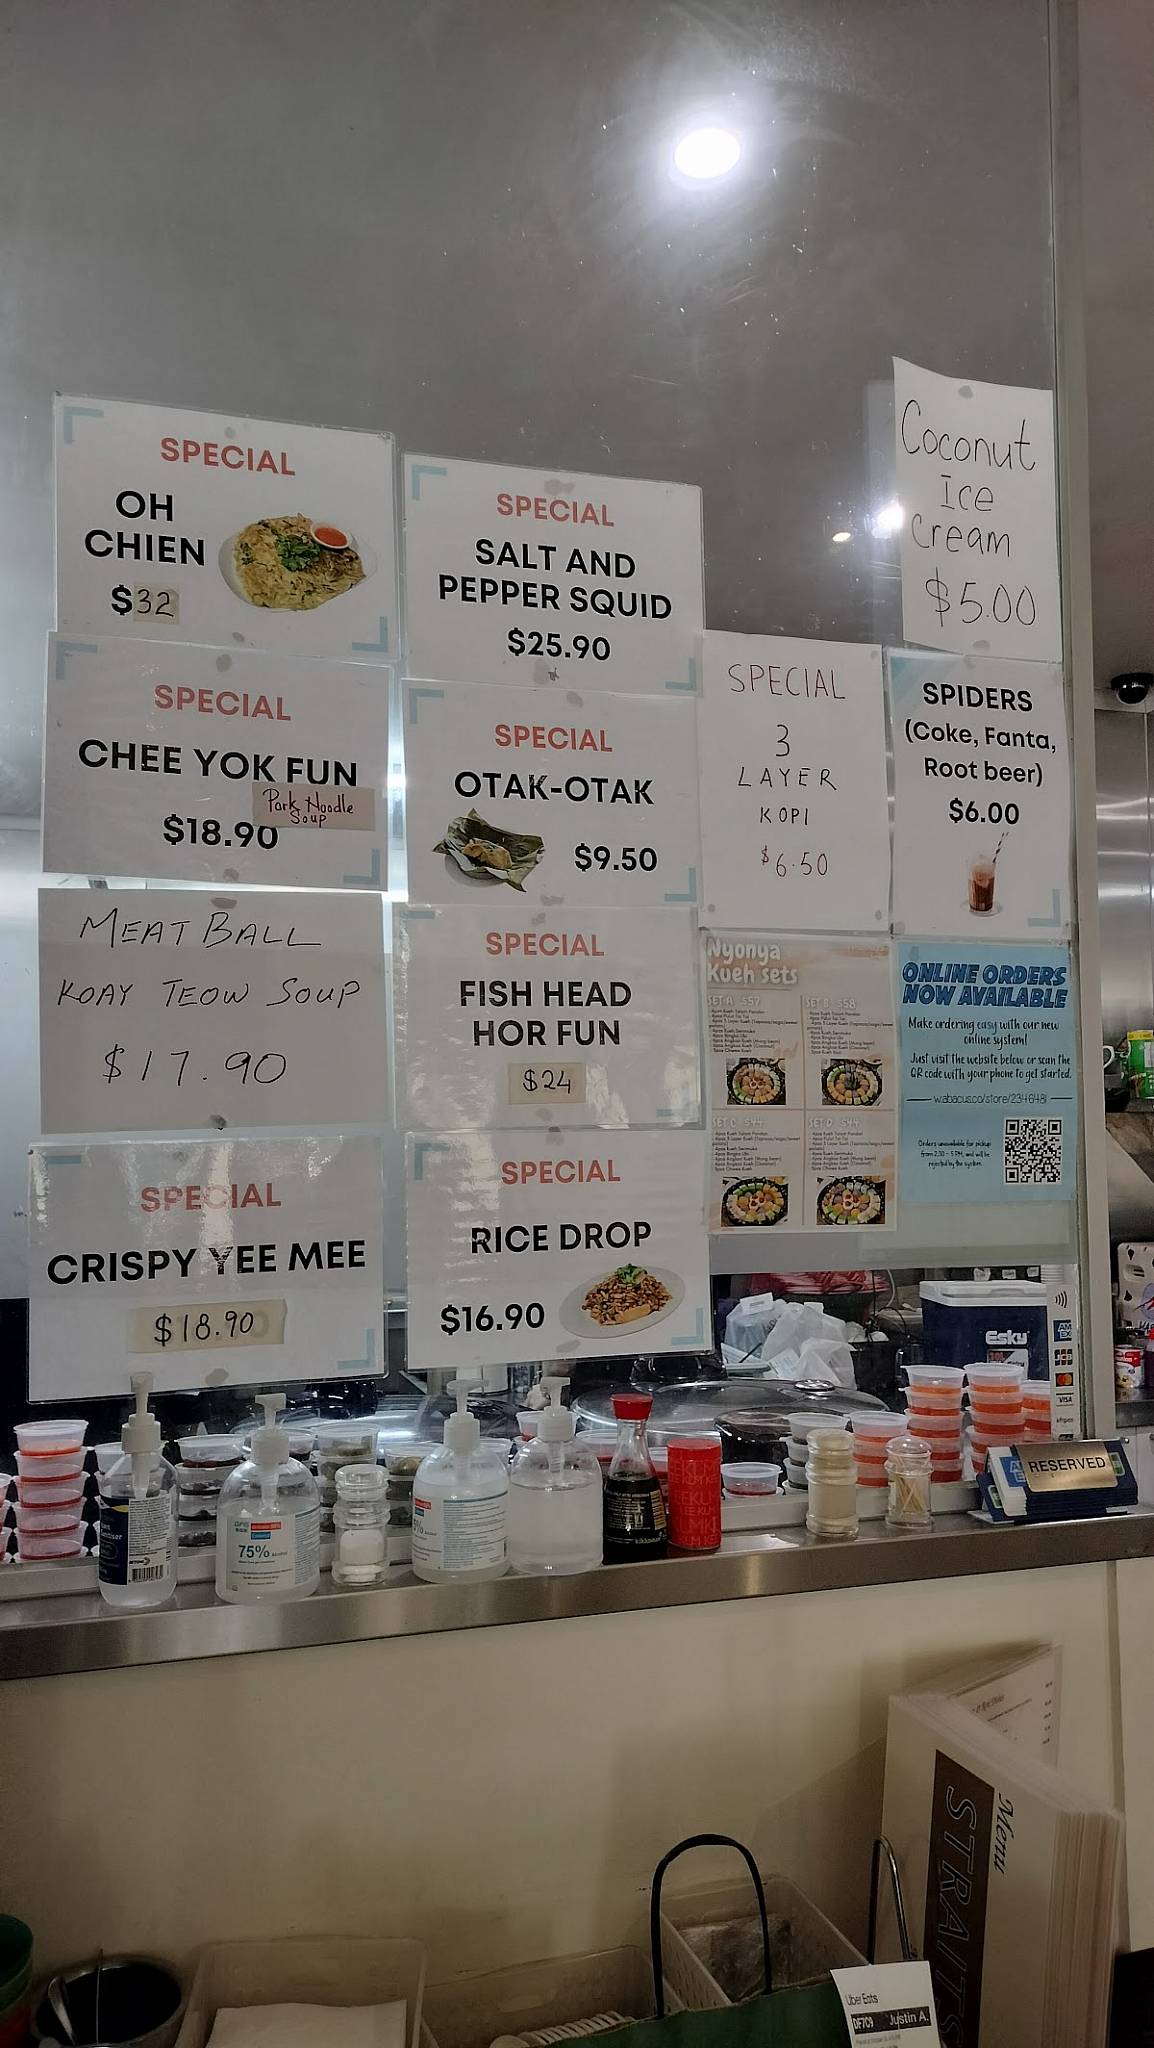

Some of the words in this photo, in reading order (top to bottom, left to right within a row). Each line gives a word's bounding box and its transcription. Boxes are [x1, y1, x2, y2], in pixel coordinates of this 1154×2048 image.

[901, 399, 1036, 472] Coconut
[160, 437, 296, 477] SPECIAL
[115, 490, 174, 523] OH
[941, 475, 994, 512] Ice
[496, 493, 615, 528] SPECIAL
[84, 529, 205, 567] CHIEN
[475, 538, 557, 571] SALT
[566, 549, 636, 579] AND
[111, 584, 175, 616] $32
[439, 574, 561, 611] PEPPER
[570, 587, 672, 620] SQUID
[924, 567, 1037, 628] $5.00
[507, 627, 611, 661] $25.90
[727, 663, 845, 700] SPECIAL
[922, 682, 1033, 712] SPIDERS
[154, 684, 291, 721] SPECIAL
[495, 724, 614, 753] SPECIAL
[776, 724, 791, 757] 3
[905, 718, 979, 748] (Coke,
[985, 726, 1056, 753] Fanta,
[78, 738, 182, 776] CHEE
[193, 749, 275, 783] YOK
[287, 757, 358, 787] FUN
[923, 758, 979, 782] Root
[984, 760, 1043, 787] beer)
[454, 771, 655, 805] OTAK-OTAK
[738, 767, 837, 790] LAYER
[760, 806, 809, 826] KOPI
[948, 800, 1020, 825] $6.00
[163, 813, 279, 850] $18.90
[574, 843, 658, 872] $9.50
[761, 846, 828, 877] $6.50
[79, 908, 190, 948] MEAT
[203, 911, 321, 948] BALL
[486, 932, 604, 957] SPECIAL
[707, 938, 781, 965] Nyonya
[707, 963, 755, 985] Kueh
[761, 966, 798, 985] sets
[902, 962, 980, 983] ONLINE
[982, 964, 1067, 985] ORDERS
[57, 979, 133, 1006] KOAY
[162, 978, 250, 1008] TEOW
[265, 977, 360, 1008] SOUP
[460, 980, 532, 1007] FISH
[543, 980, 632, 1008] HEAD
[903, 984, 956, 1006] NOW
[958, 986, 1068, 1008] AVAILABLE
[473, 1019, 547, 1047] HOR
[558, 1019, 621, 1046] FUN
[908, 1017, 933, 1029] Make
[935, 1018, 975, 1036] ordering
[977, 1021, 997, 1035] easy
[999, 1018, 1020, 1030] with
[1022, 1022, 1039, 1030] our
[1041, 1022, 1060, 1030] new
[964, 1033, 991, 1045] online
[993, 1034, 1028, 1050] system!
[102, 1043, 287, 1087] $17.90
[910, 1053, 929, 1064] Just
[931, 1054, 949, 1064] visit
[952, 1053, 965, 1064] the
[966, 1053, 998, 1065] website
[1000, 1054, 1025, 1065] below
[1026, 1057, 1037, 1065] or
[1037, 1056, 1056, 1065] scan
[1058, 1054, 1071, 1065] the
[522, 1069, 572, 1094] $24
[910, 1067, 923, 1078] QR
[924, 1067, 943, 1079] code
[944, 1068, 965, 1080] with
[967, 1070, 989, 1083] your
[989, 1068, 1014, 1083] phone
[1015, 1068, 1024, 1079] to
[1025, 1068, 1038, 1083] get
[1040, 1068, 1072, 1079] started.
[501, 1159, 620, 1185] SPECIAL
[140, 1181, 281, 1213] SPECIAL
[471, 1223, 549, 1254] RICE
[560, 1221, 652, 1250] DROP
[47, 1247, 197, 1285] CRISPY
[208, 1243, 277, 1275] YEE
[288, 1239, 365, 1271] MEE
[154, 1310, 254, 1346] $18.90
[440, 1302, 545, 1335] $16.90
[985, 1330, 1028, 1345] Esky
[1028, 1456, 1106, 1473] RESERVED
[238, 1545, 270, 1558] 75%
[994, 1793, 1014, 1875] Menu
[935, 1785, 977, 2048] STRAITS
[862, 1993, 879, 2005] Eats
[889, 2011, 917, 2026] Justin
[919, 2010, 929, 2022] A.
